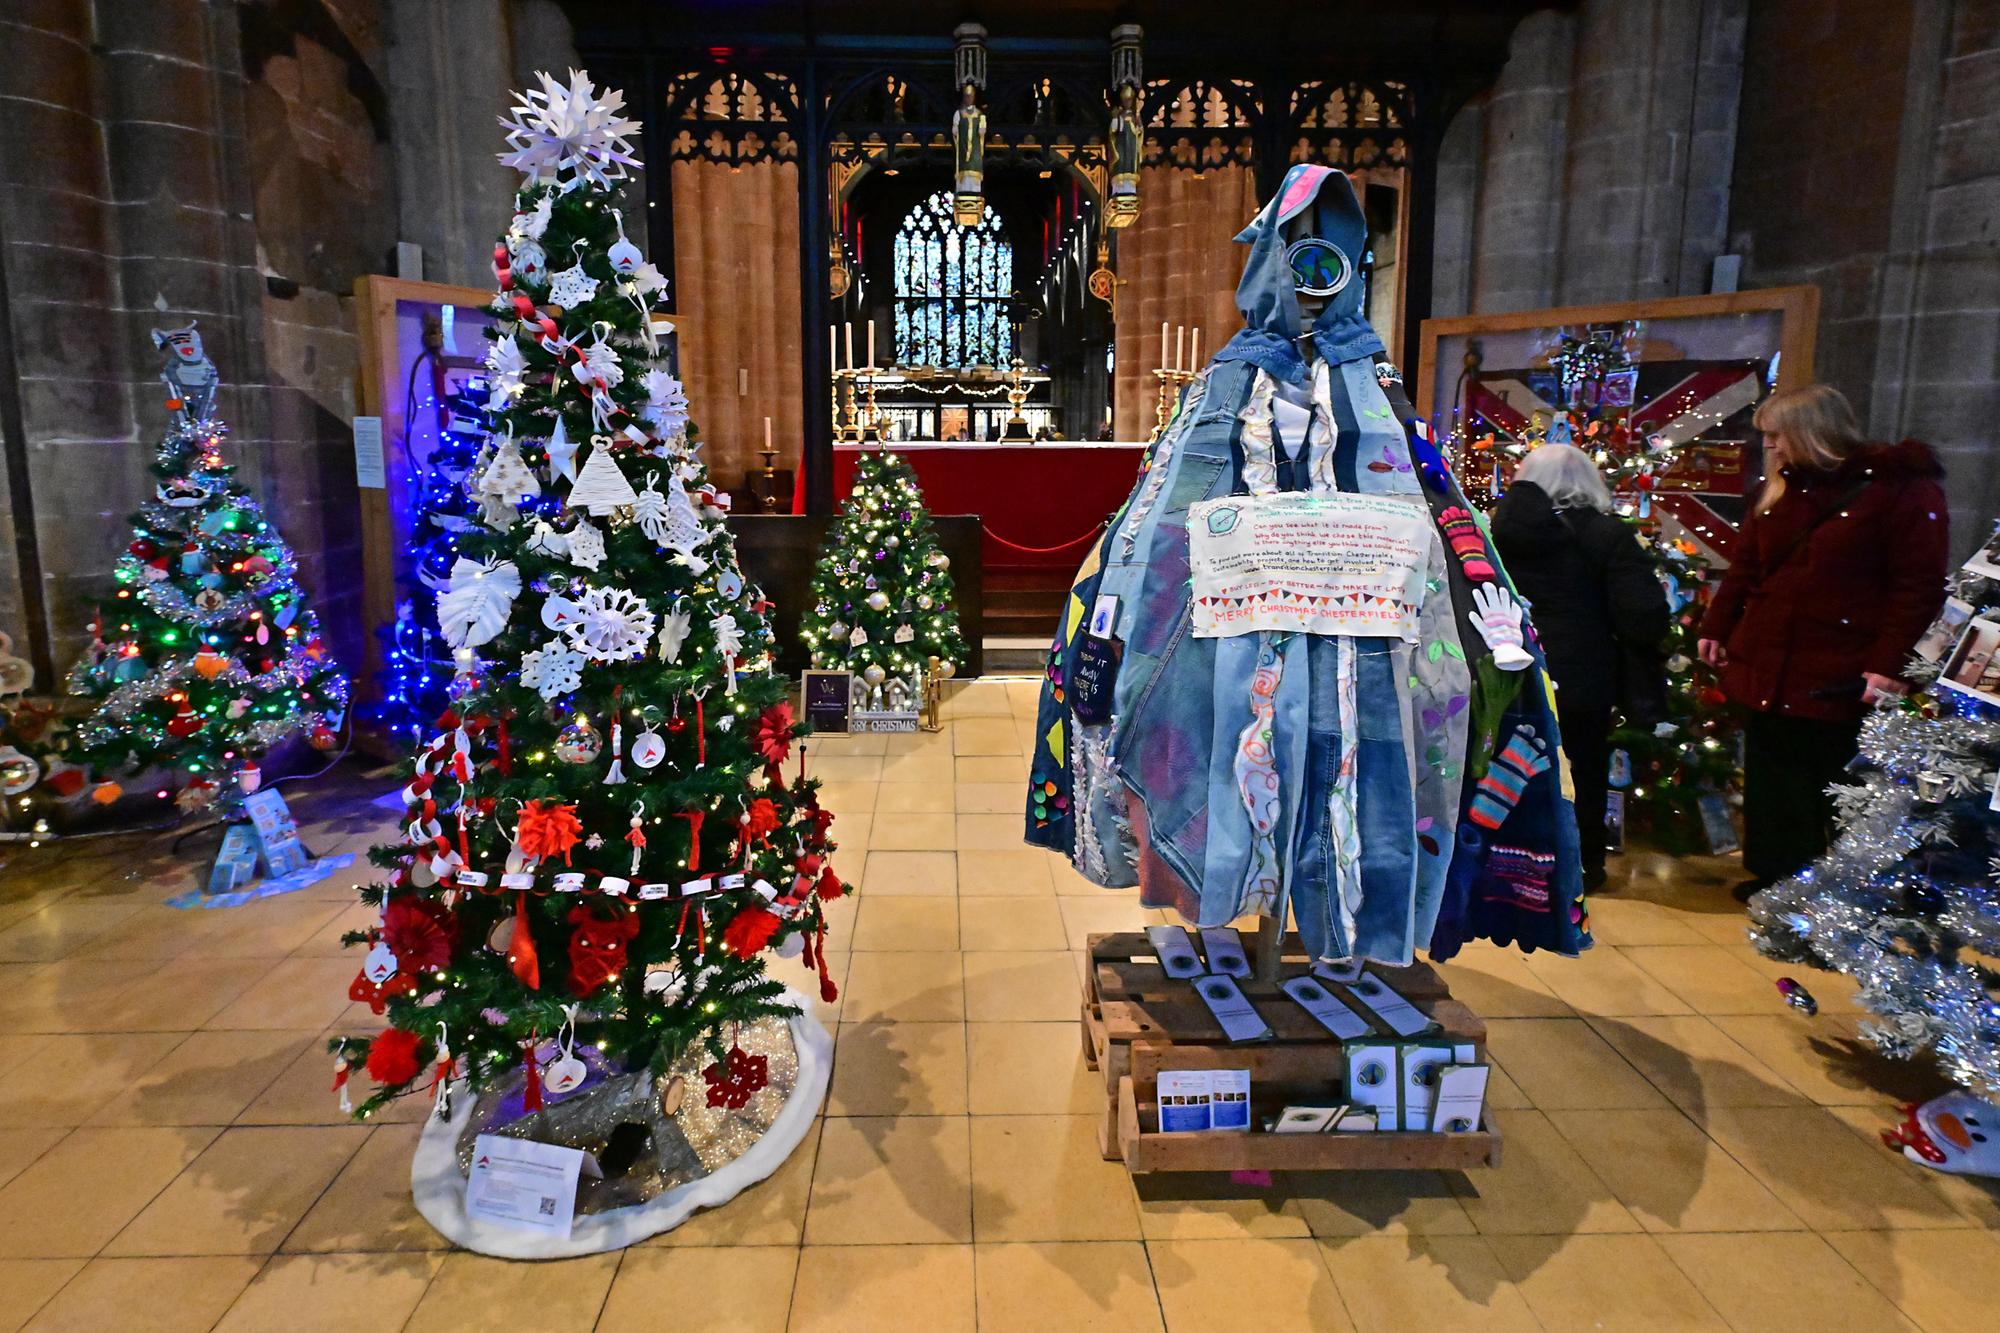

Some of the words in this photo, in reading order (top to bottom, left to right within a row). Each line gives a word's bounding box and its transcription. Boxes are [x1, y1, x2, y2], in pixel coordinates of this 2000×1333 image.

[1282, 540, 1311, 548] anything
[1327, 558, 1340, 566] get
[1287, 580, 1315, 589] BETTER
[1324, 583, 1340, 591] AND
[1215, 605, 1254, 622] MERRY
[1259, 604, 1317, 615] CHRISTMAS
[1320, 609, 1401, 619] CHESTERFIELD
[1097, 658, 1107, 668] IT
[1090, 683, 1099, 695] IS
[871, 720, 916, 731] CHRISTMAS
